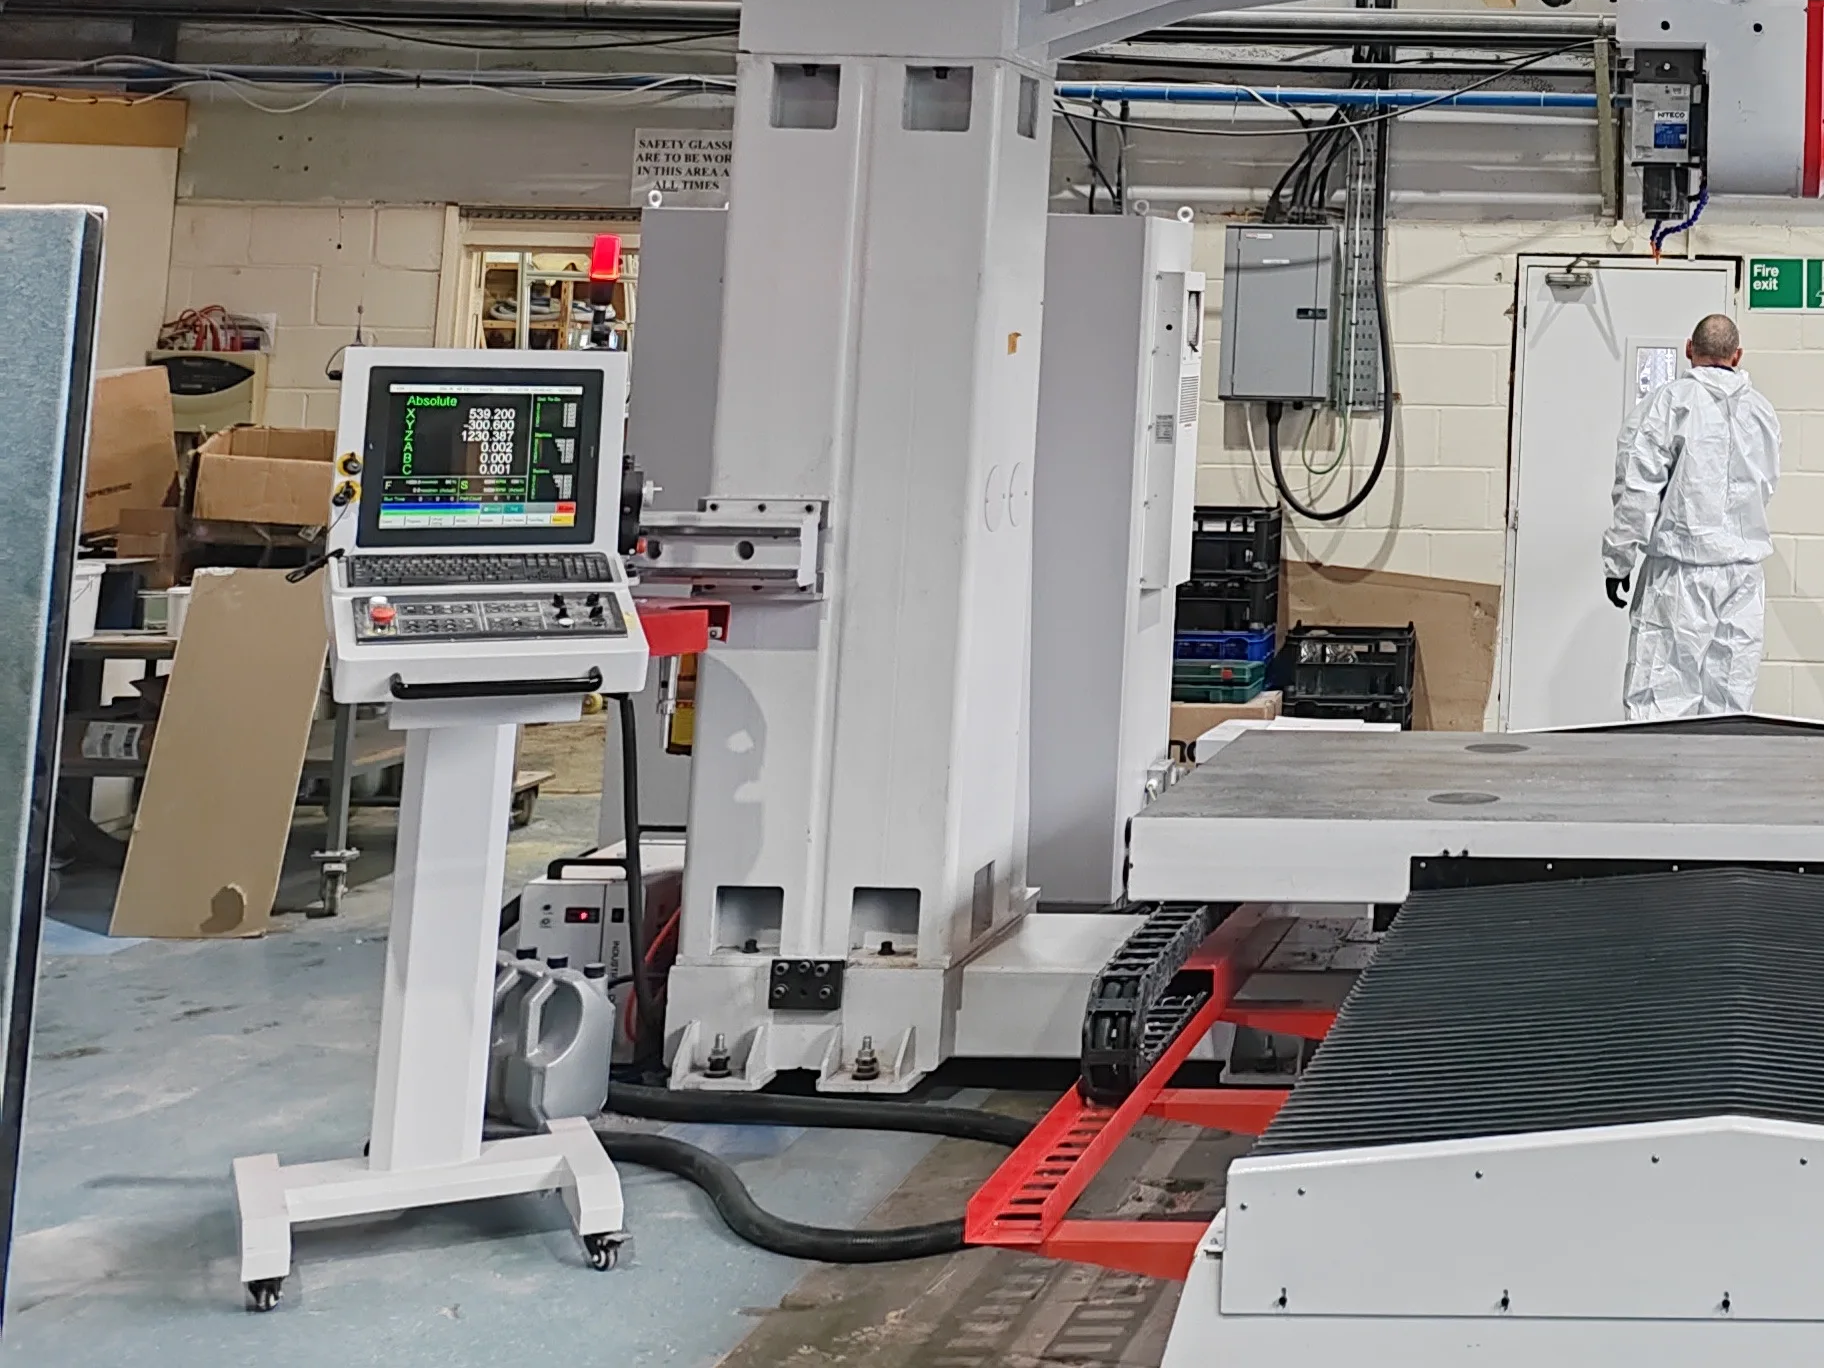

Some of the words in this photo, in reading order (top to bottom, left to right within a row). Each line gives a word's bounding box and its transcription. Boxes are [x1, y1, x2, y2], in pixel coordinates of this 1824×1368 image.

[639, 139, 685, 150] SAFETY
[636, 153, 660, 163] ARE
[664, 153, 681, 163] TO
[685, 153, 700, 164] BE
[637, 166, 650, 175] IN
[653, 166, 682, 176] THIS
[685, 167, 718, 177] AREA
[653, 180, 678, 191] ALL
[682, 180, 719, 190] TIMES
[1753, 264, 1779, 277] Fire
[1753, 277, 1778, 290] exit
[406, 395, 458, 407] Absolute
[405, 408, 416, 419] X
[469, 408, 516, 419] 539.200
[406, 419, 415, 430] Y
[463, 420, 515, 430] -300.600
[404, 430, 414, 441] Z
[461, 430, 515, 442] 1230.387
[403, 442, 413, 452] A
[481, 442, 513, 452] 0.002
[403, 453, 412, 464] B
[480, 453, 512, 464] 0.000
[402, 464, 412, 475] C
[479, 464, 511, 475] 0.001
[385, 480, 393, 490] F
[460, 480, 469, 490] S
